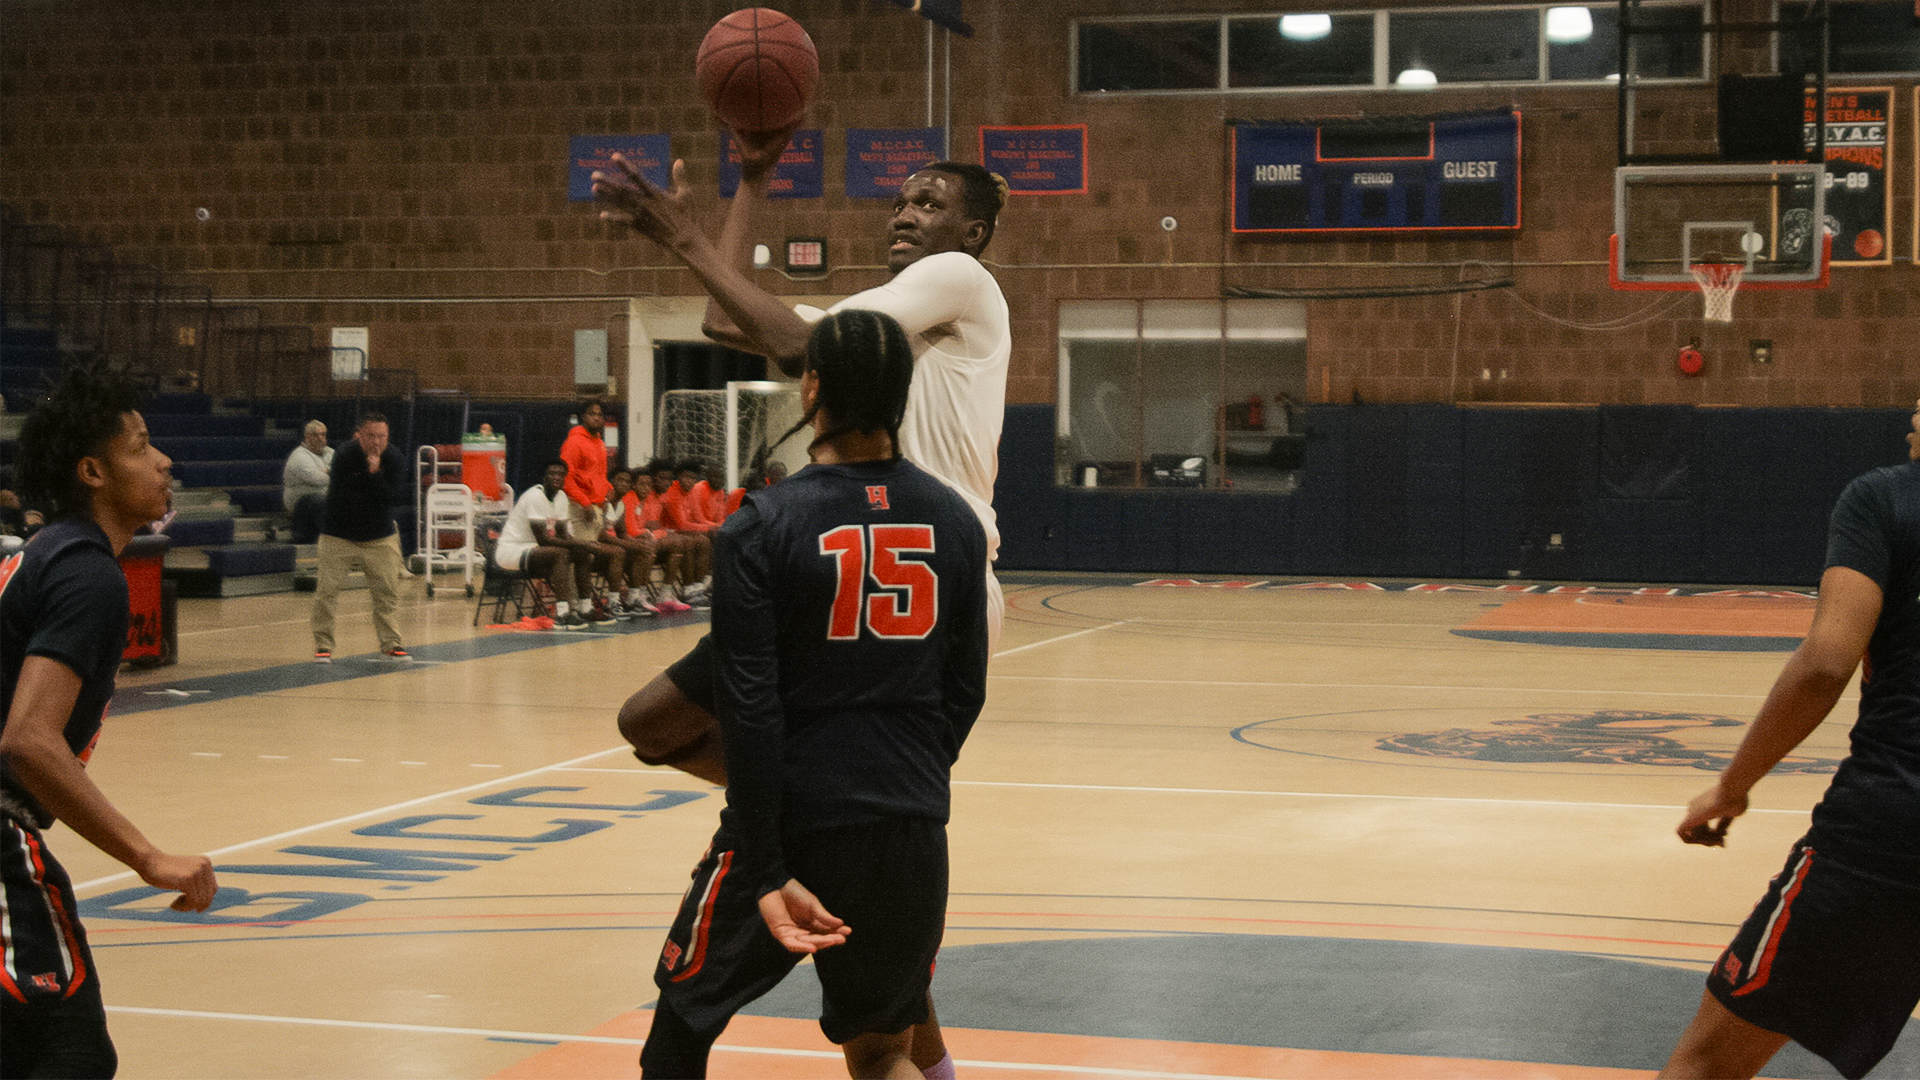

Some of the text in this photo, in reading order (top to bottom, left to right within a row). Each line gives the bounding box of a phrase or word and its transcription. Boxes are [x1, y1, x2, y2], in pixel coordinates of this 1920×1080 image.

[1255, 164, 1302, 181] HOME
[1353, 172, 1394, 184] PERIOD
[1443, 161, 1498, 178] GUEST
[818, 523, 938, 640] 15
[1132, 578, 1818, 599] MANHA
